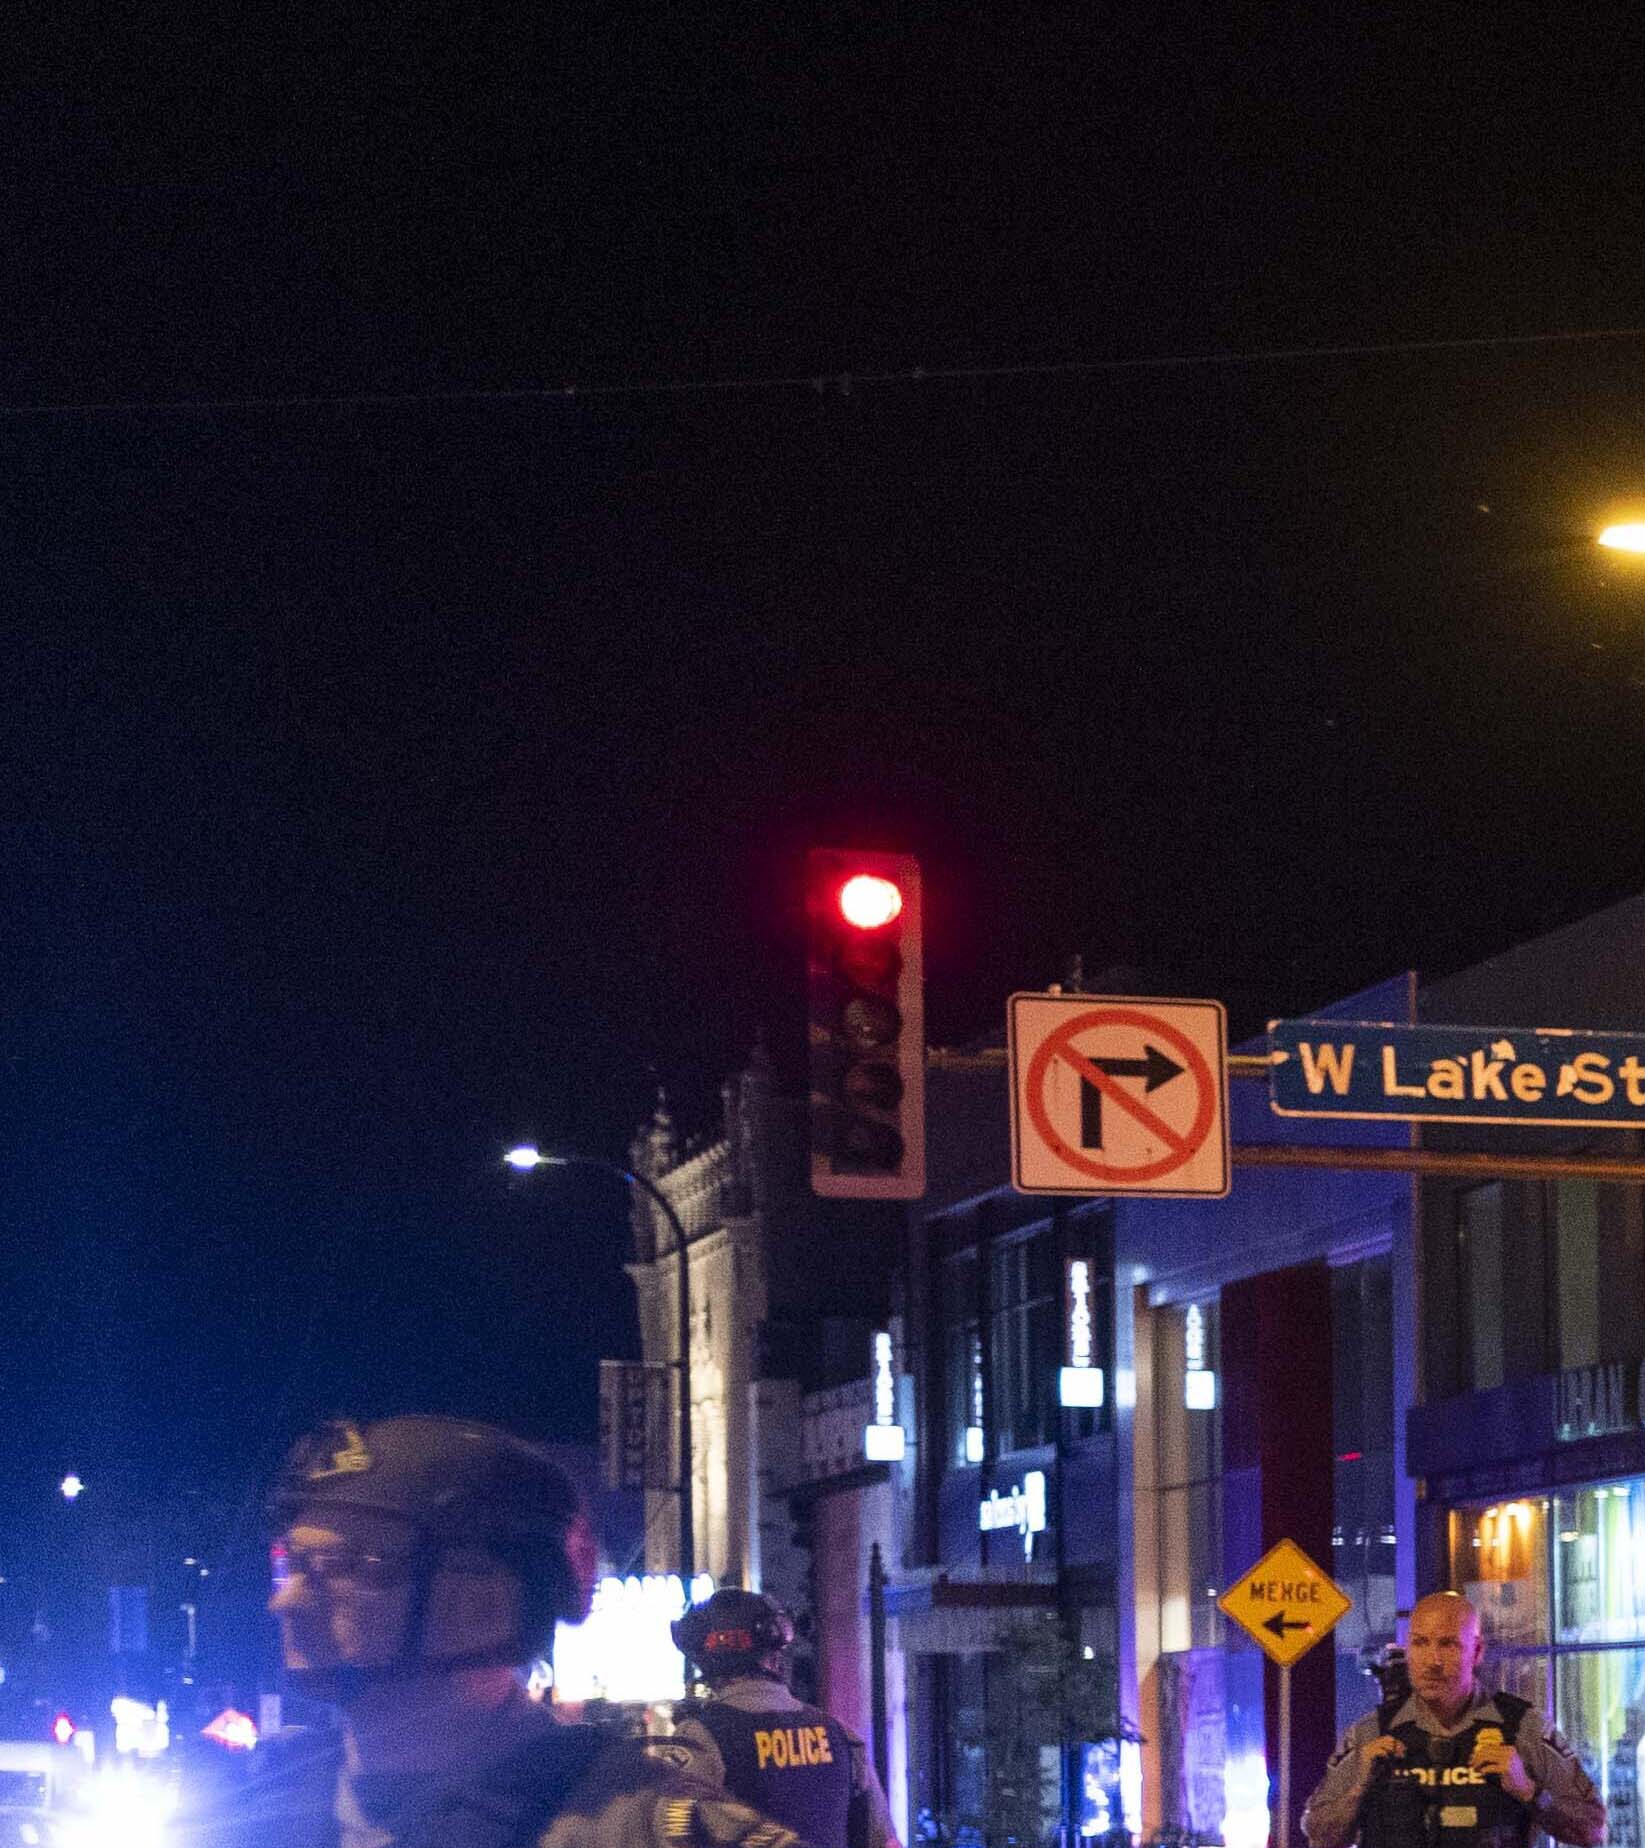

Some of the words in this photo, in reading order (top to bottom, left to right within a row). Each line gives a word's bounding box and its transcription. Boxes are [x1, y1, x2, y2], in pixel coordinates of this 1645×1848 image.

[1299, 1043, 1355, 1096] W
[1383, 1043, 1547, 1103] Lake
[1249, 1581, 1321, 1603] MERGE
[753, 1725, 833, 1770] POLICE
[1394, 1766, 1487, 1787] OLICE
